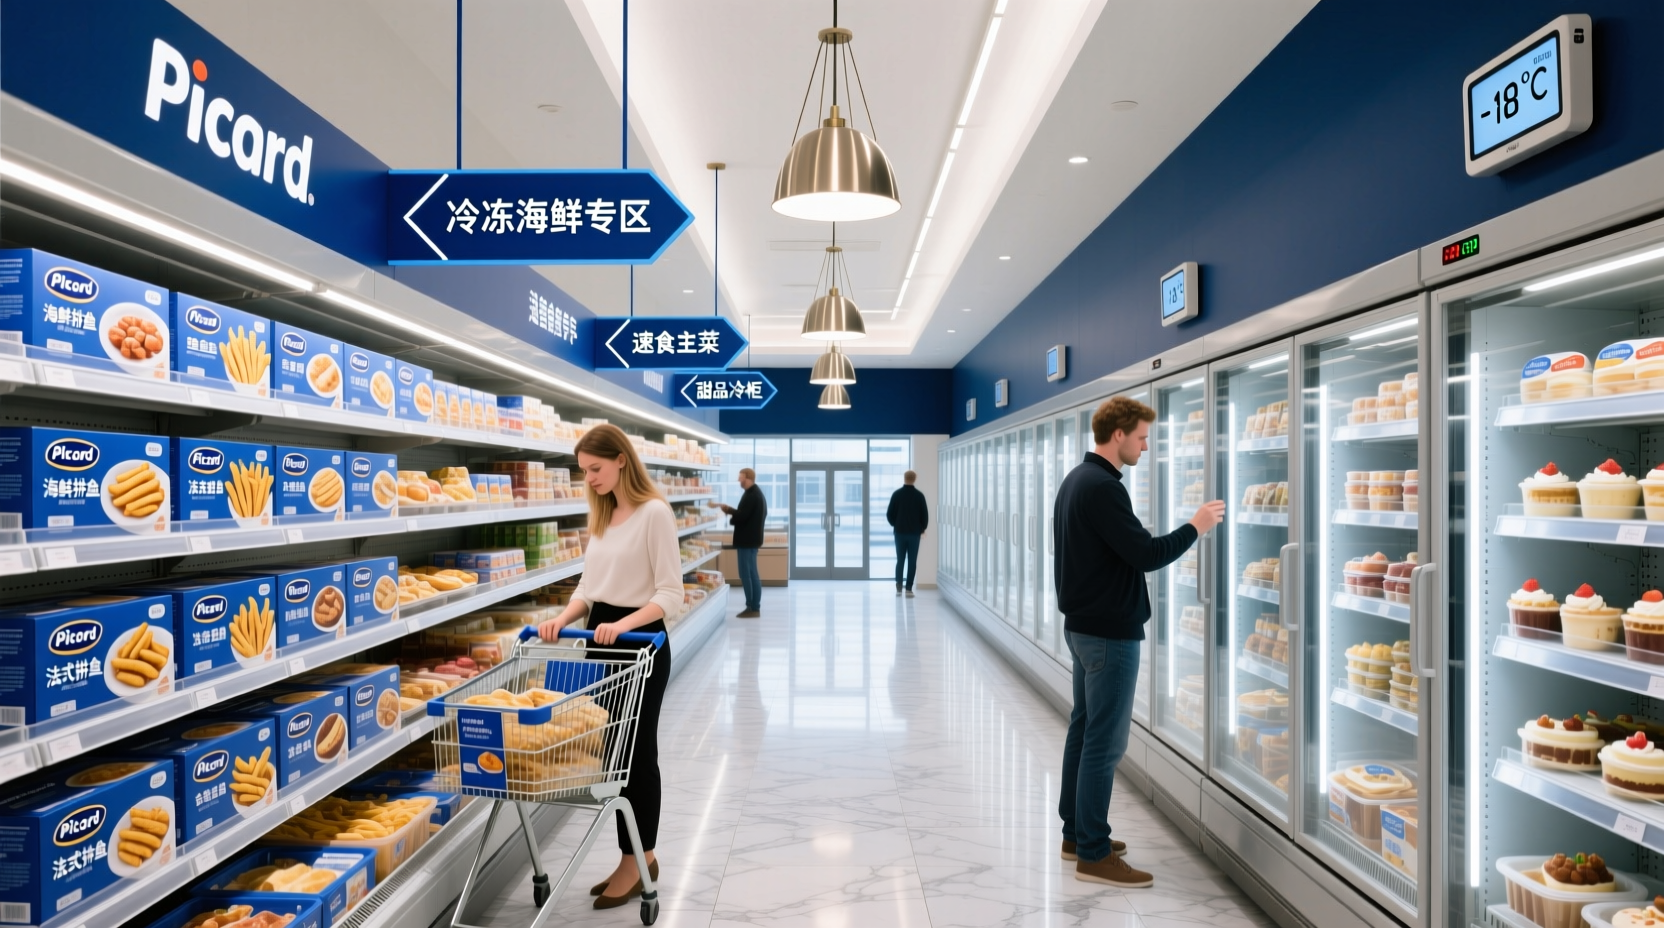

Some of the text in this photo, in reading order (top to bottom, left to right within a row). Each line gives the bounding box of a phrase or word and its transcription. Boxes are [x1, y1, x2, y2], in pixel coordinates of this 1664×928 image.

[1480, 66, 1548, 124] -18°C
[446, 198, 651, 235] 冷冻海鲜专区
[632, 329, 720, 355] 速食主菜
[695, 380, 764, 400] 甜品冷柜
